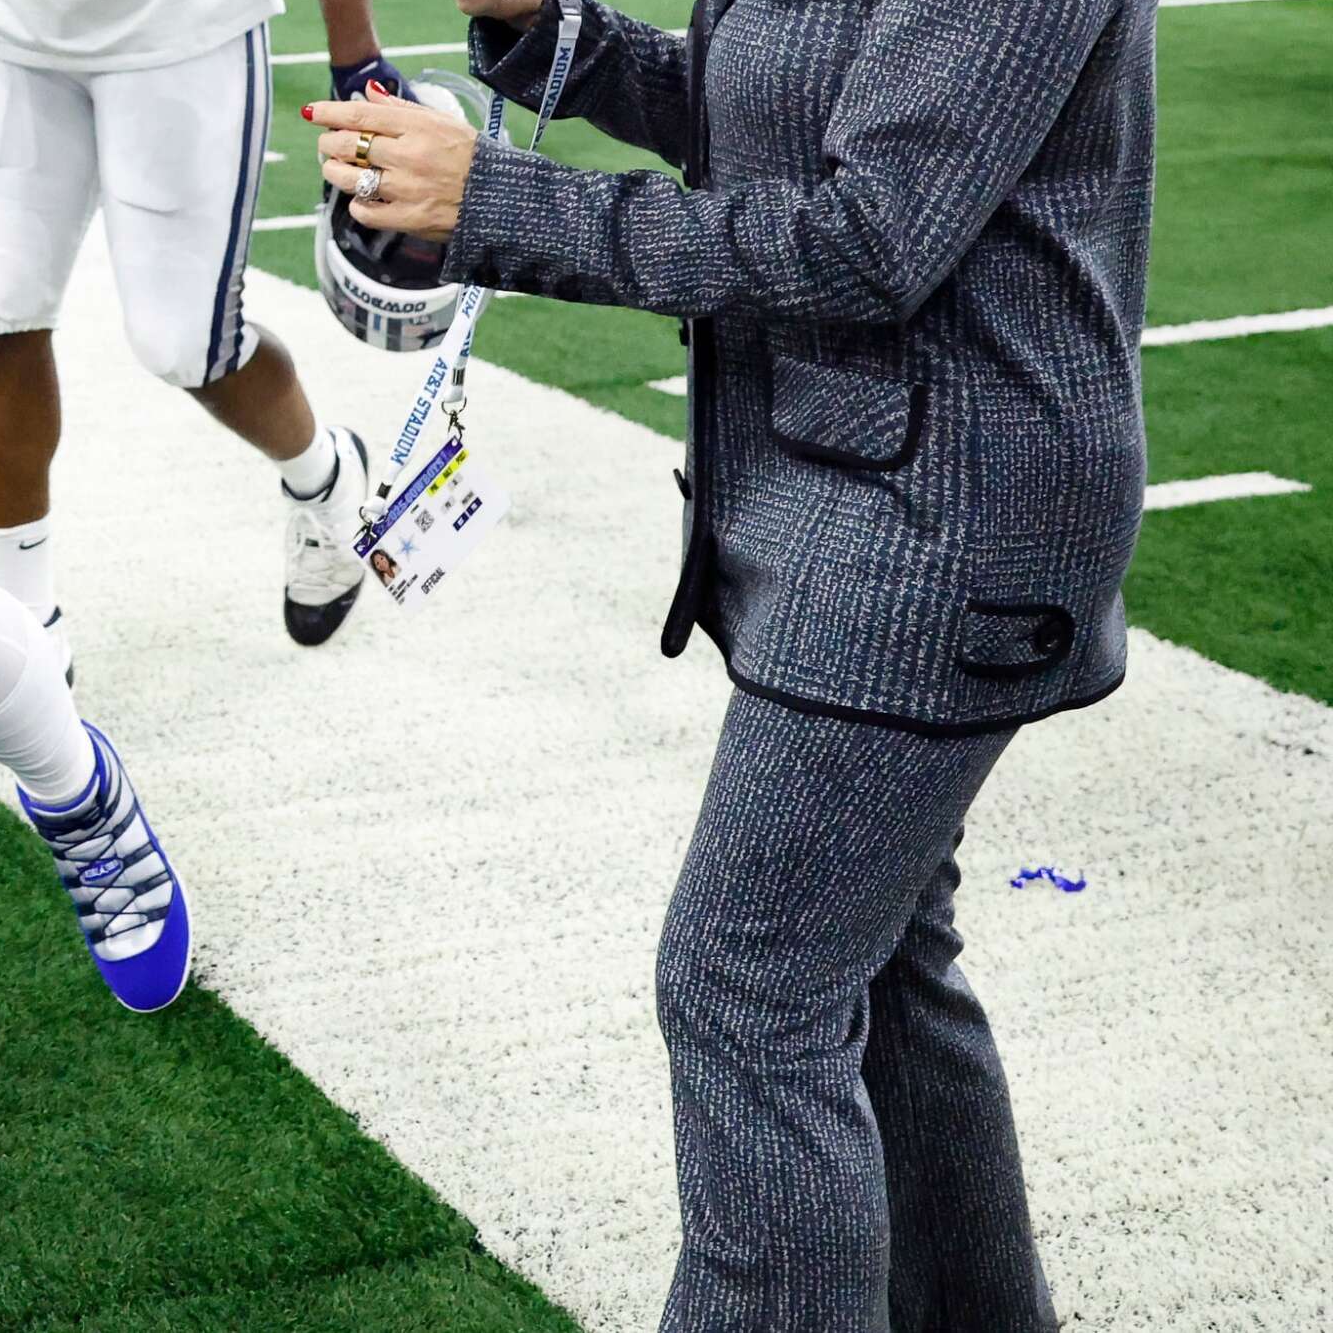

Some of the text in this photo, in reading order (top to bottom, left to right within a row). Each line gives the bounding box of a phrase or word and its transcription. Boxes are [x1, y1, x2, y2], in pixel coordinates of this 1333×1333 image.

[542, 46, 572, 117] STADIUM
[344, 276, 427, 314] COWBOYS
[390, 356, 449, 467] AT&T STADIUM
